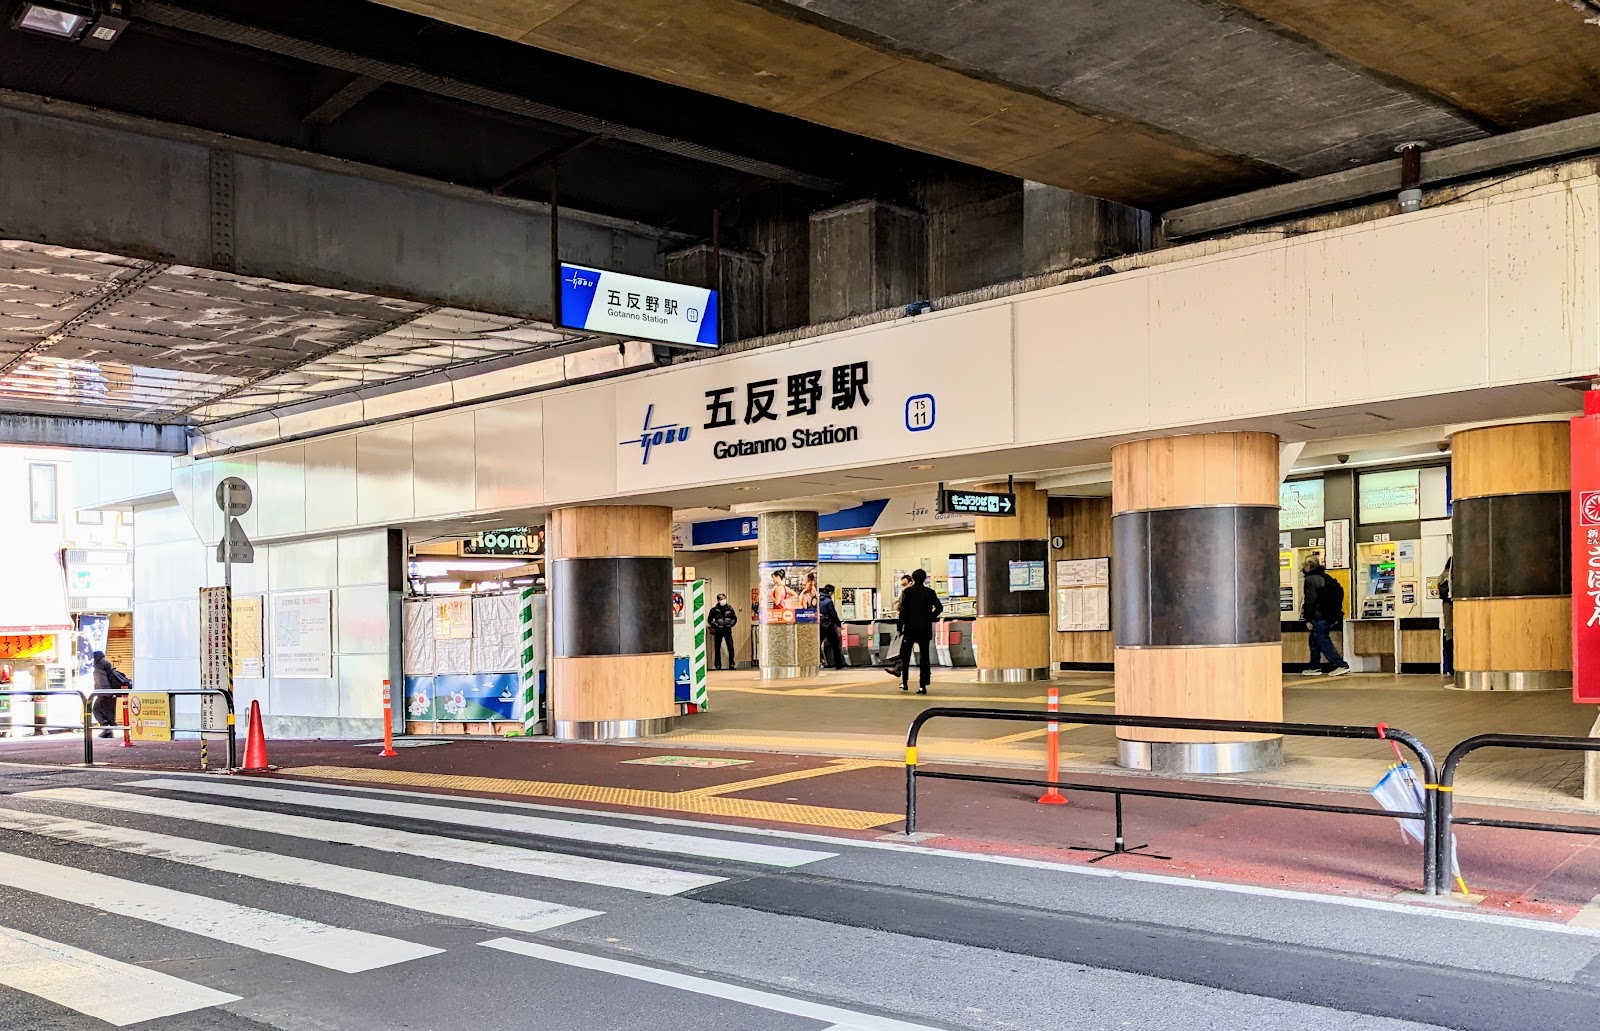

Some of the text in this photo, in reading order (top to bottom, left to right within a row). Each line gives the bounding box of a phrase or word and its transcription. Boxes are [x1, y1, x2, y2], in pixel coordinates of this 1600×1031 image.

[607, 289, 678, 316] 五反野駅
[607, 308, 669, 325] Gotanno Station
[703, 360, 870, 430] 五反野駅
[914, 400, 926, 410] TS
[913, 411, 928, 426] 11
[713, 424, 858, 460] Gotanno Station
[951, 495, 988, 507] きっぷうりば
